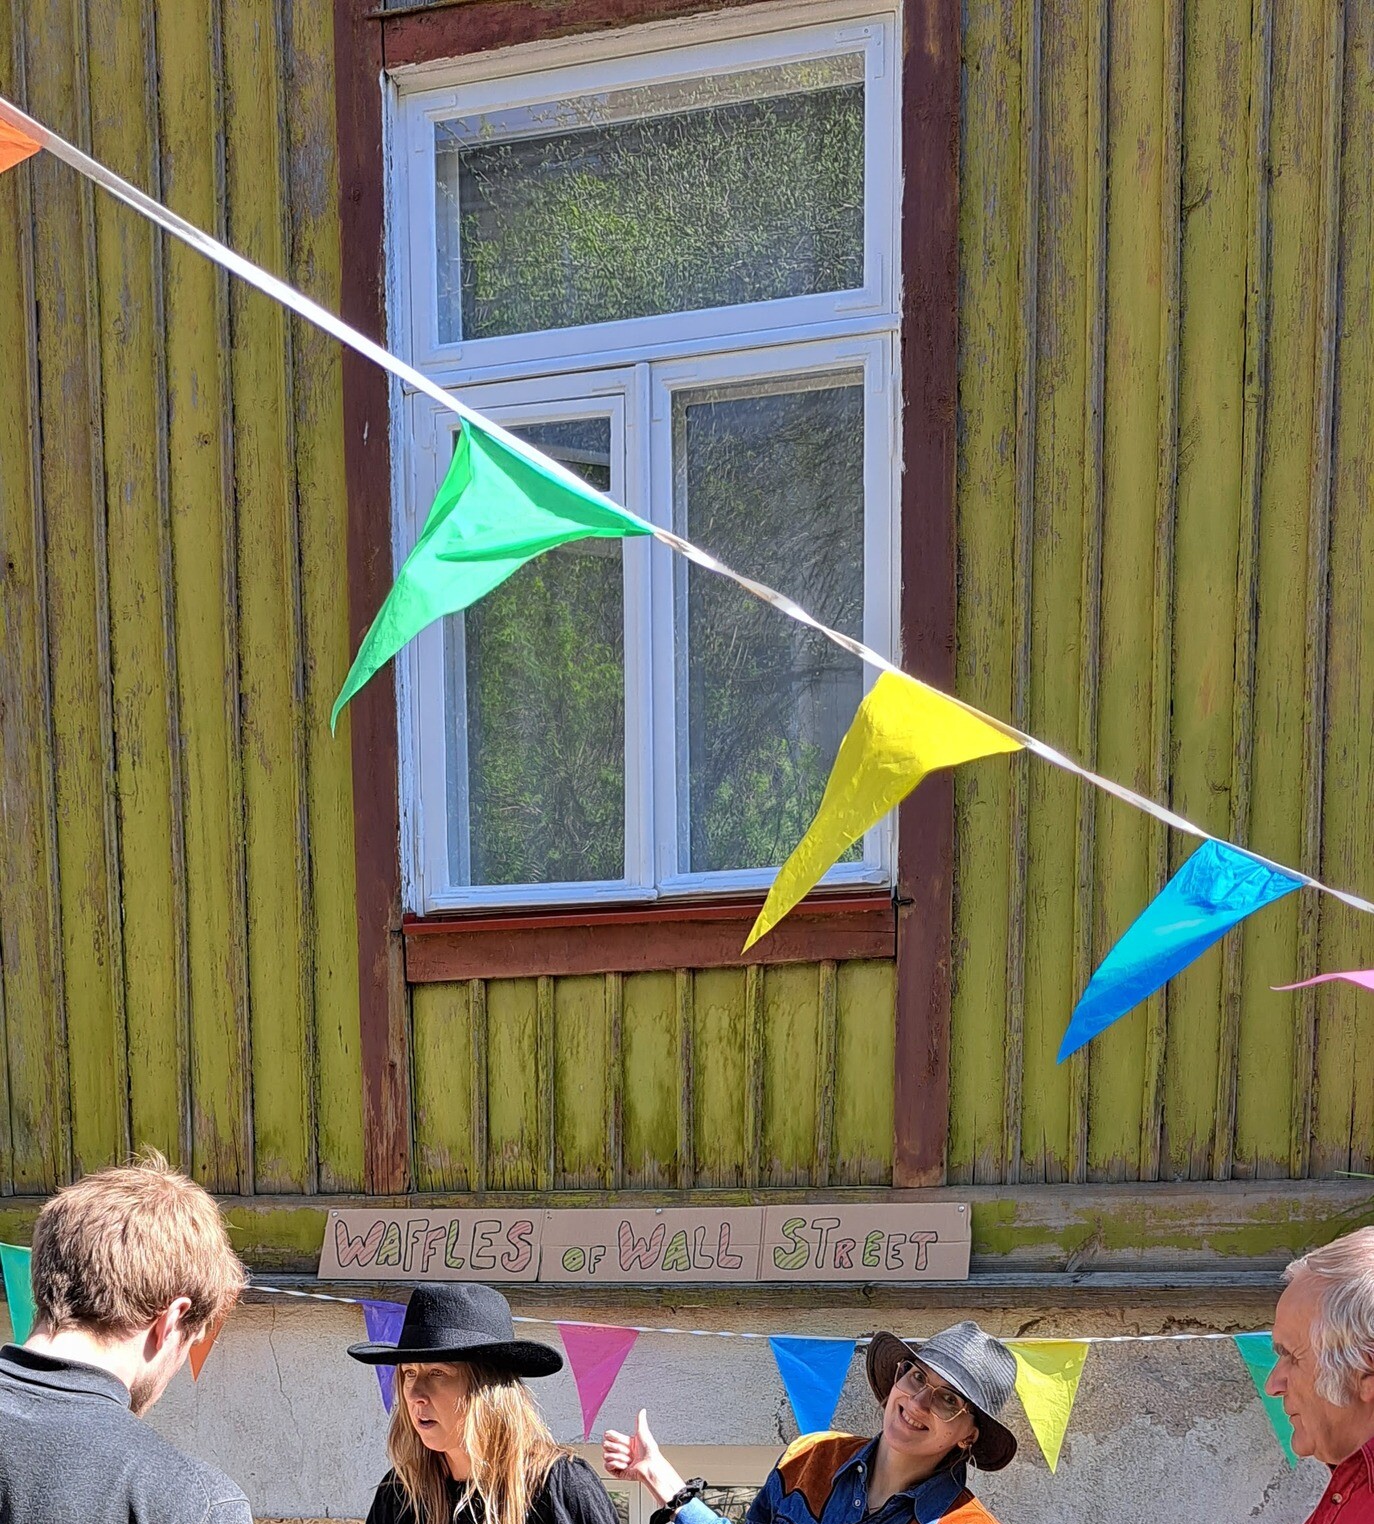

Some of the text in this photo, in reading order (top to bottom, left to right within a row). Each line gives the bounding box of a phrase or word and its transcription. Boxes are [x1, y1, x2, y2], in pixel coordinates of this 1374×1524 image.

[335, 1217, 939, 1275] WAFFLES OF WALL STREET
